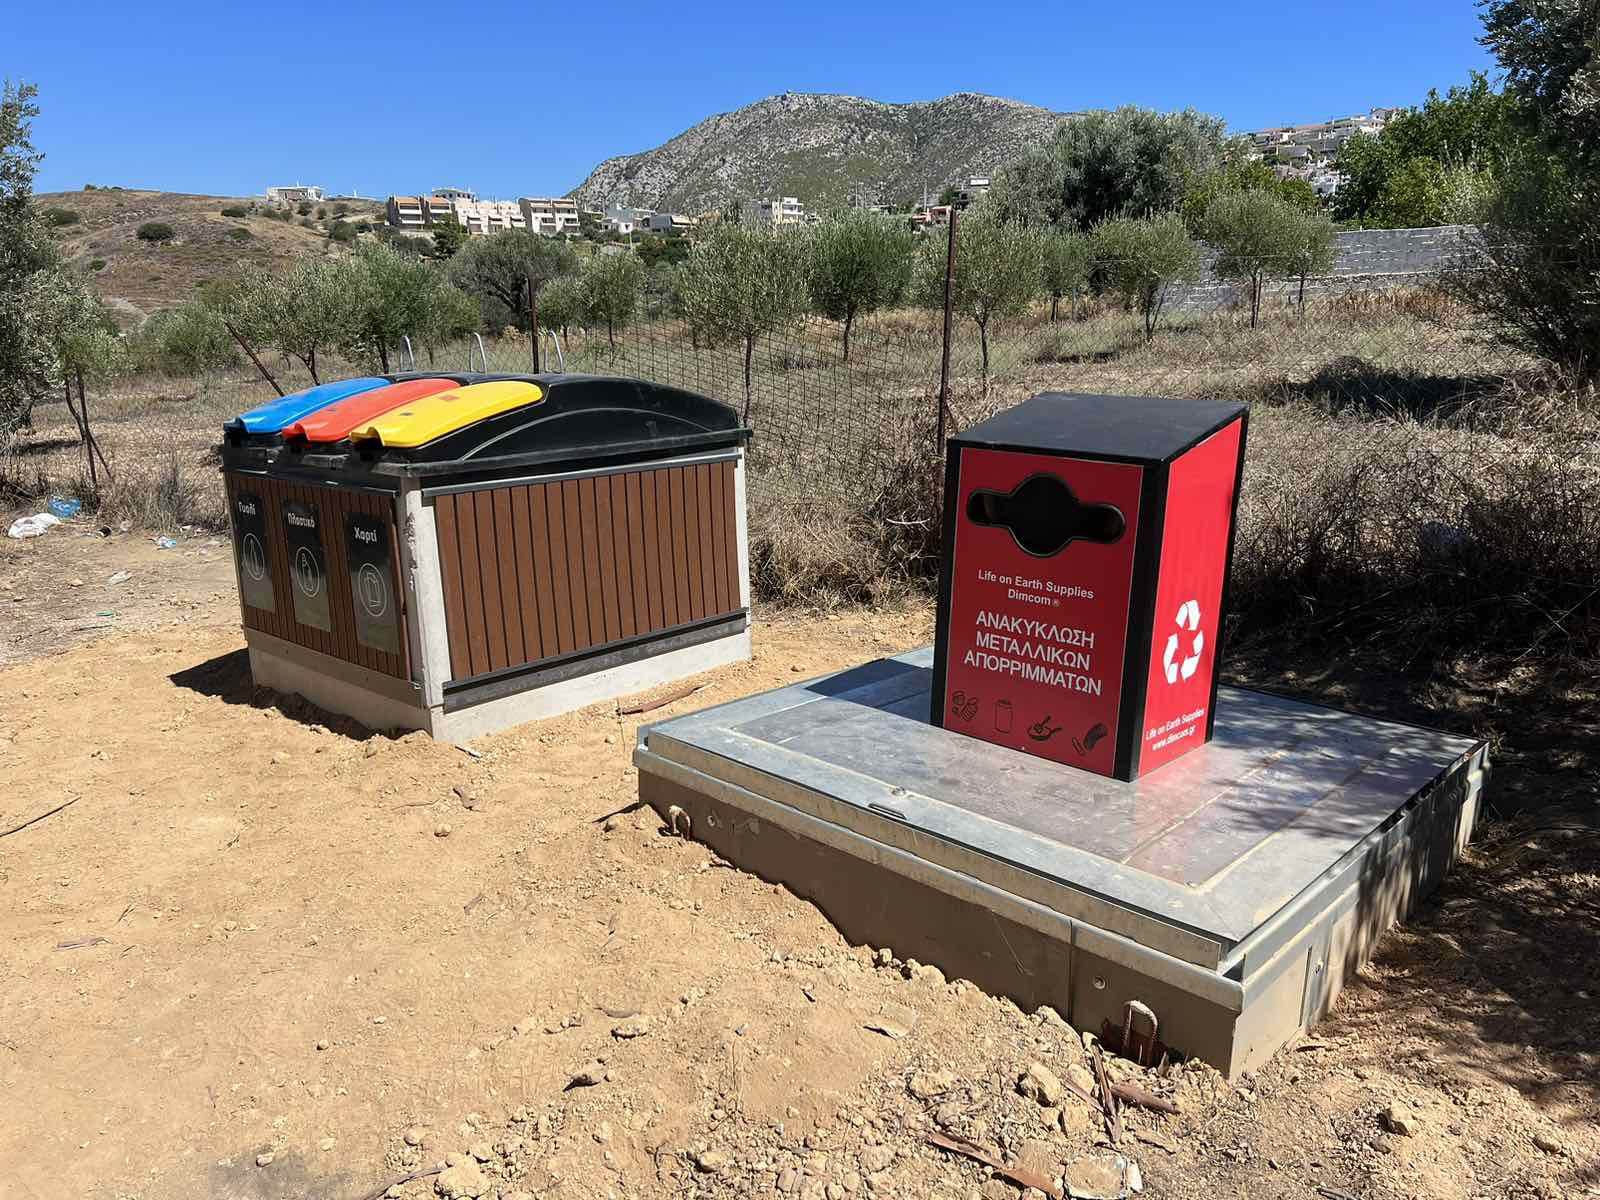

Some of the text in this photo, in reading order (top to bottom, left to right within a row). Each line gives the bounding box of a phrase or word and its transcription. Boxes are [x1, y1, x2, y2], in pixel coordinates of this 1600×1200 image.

[978, 569, 1094, 599] Life on Earth Supplies
[976, 611, 1094, 648] ΑΝΑΚΥΚΛΩΣΗ
[976, 632, 1090, 670] ΜΕΤΑΛΛΙΚΩΝ
[964, 650, 1101, 696] ΑΠΟΡΡΙΜΜΑΤΩΝ
